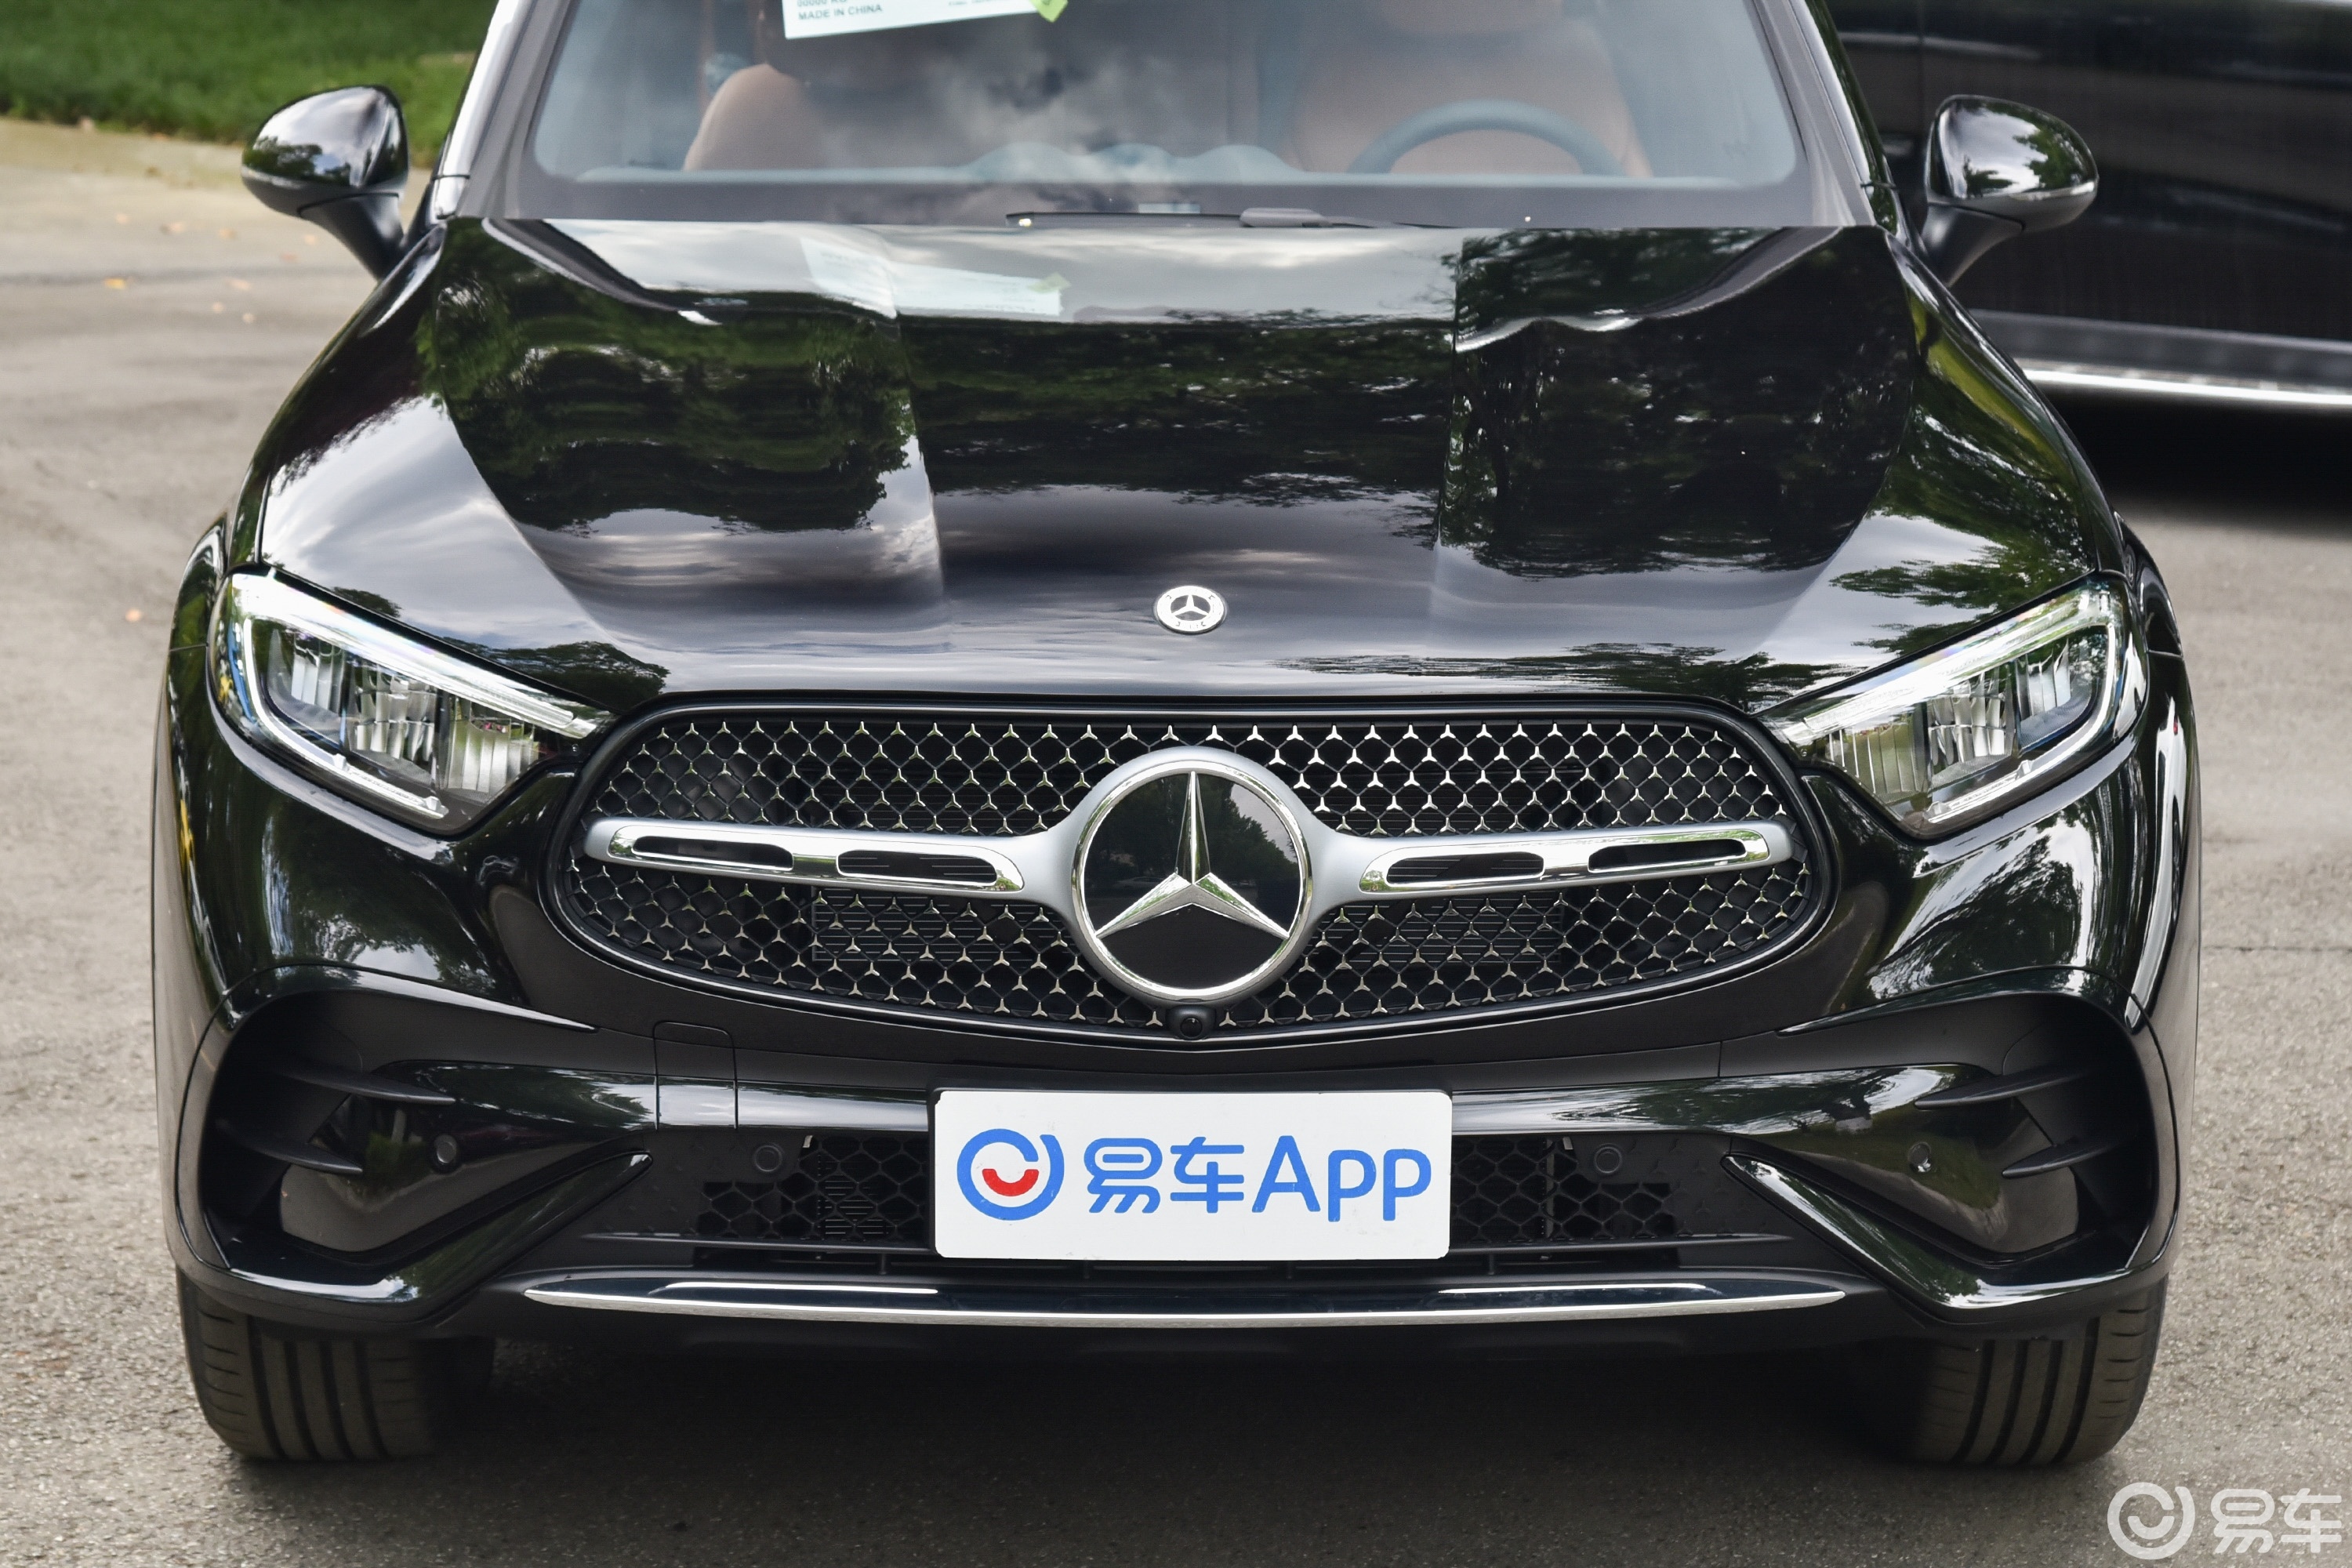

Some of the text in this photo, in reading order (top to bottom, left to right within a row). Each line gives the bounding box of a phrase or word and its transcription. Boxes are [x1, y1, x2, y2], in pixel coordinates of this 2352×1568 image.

[798, 9, 829, 20] MADE
[848, 4, 883, 15] CHINA
[1083, 1135, 1432, 1222] 易车App
